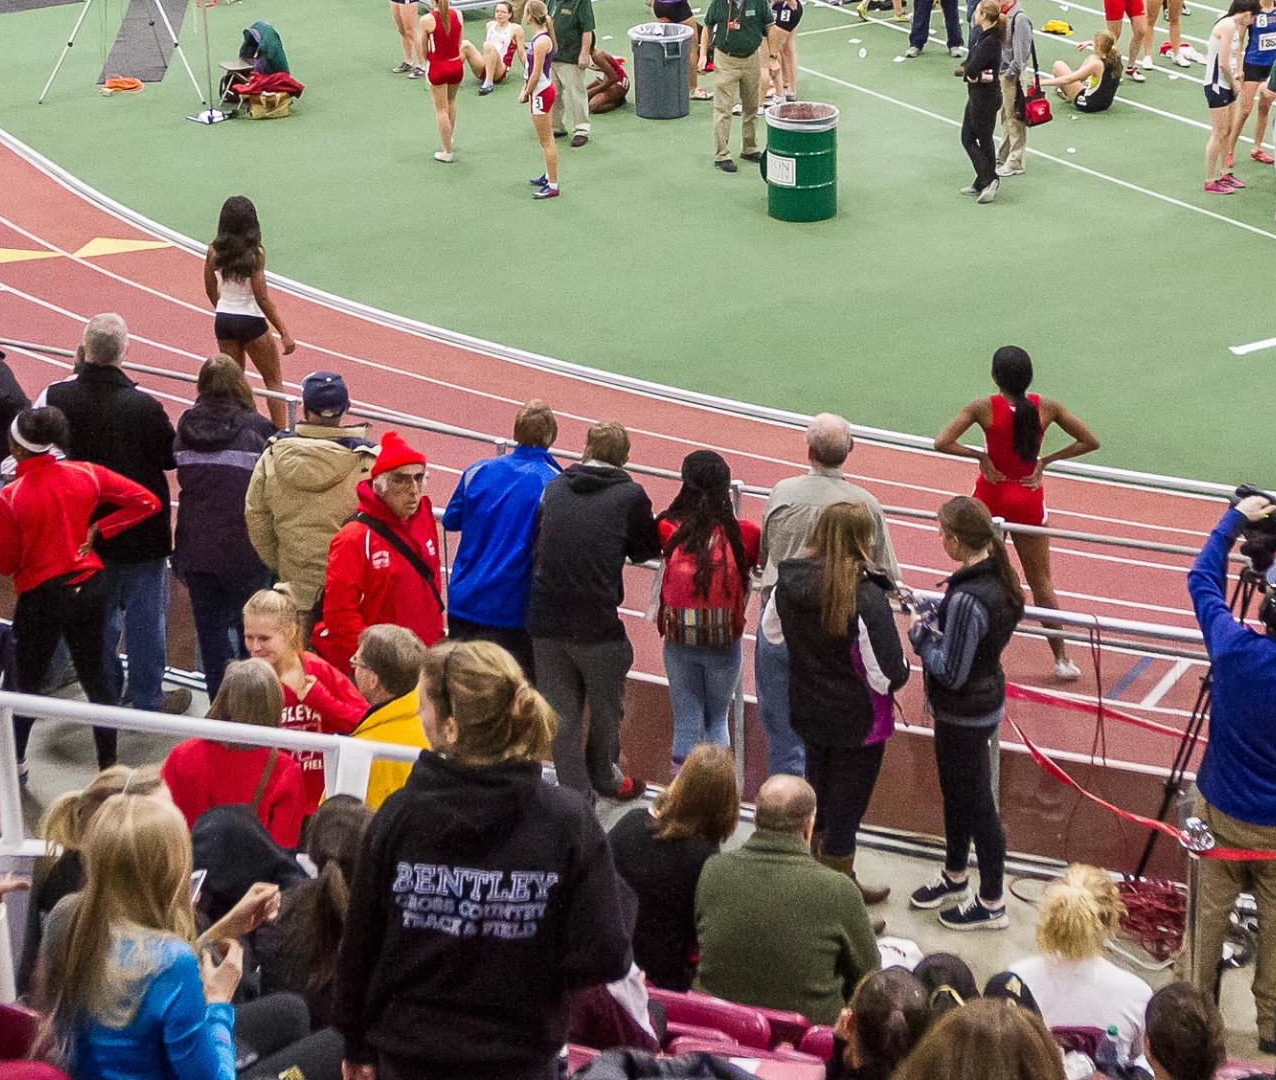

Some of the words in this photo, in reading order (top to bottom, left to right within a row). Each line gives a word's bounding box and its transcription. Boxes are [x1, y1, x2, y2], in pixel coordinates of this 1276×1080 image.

[535, 97, 541, 109] 3
[303, 759, 324, 772] FIEL
[392, 861, 559, 902] BENTLEY
[458, 898, 548, 921] COUNTRY
[402, 910, 461, 938] TRACK
[482, 920, 538, 940] FIELD
